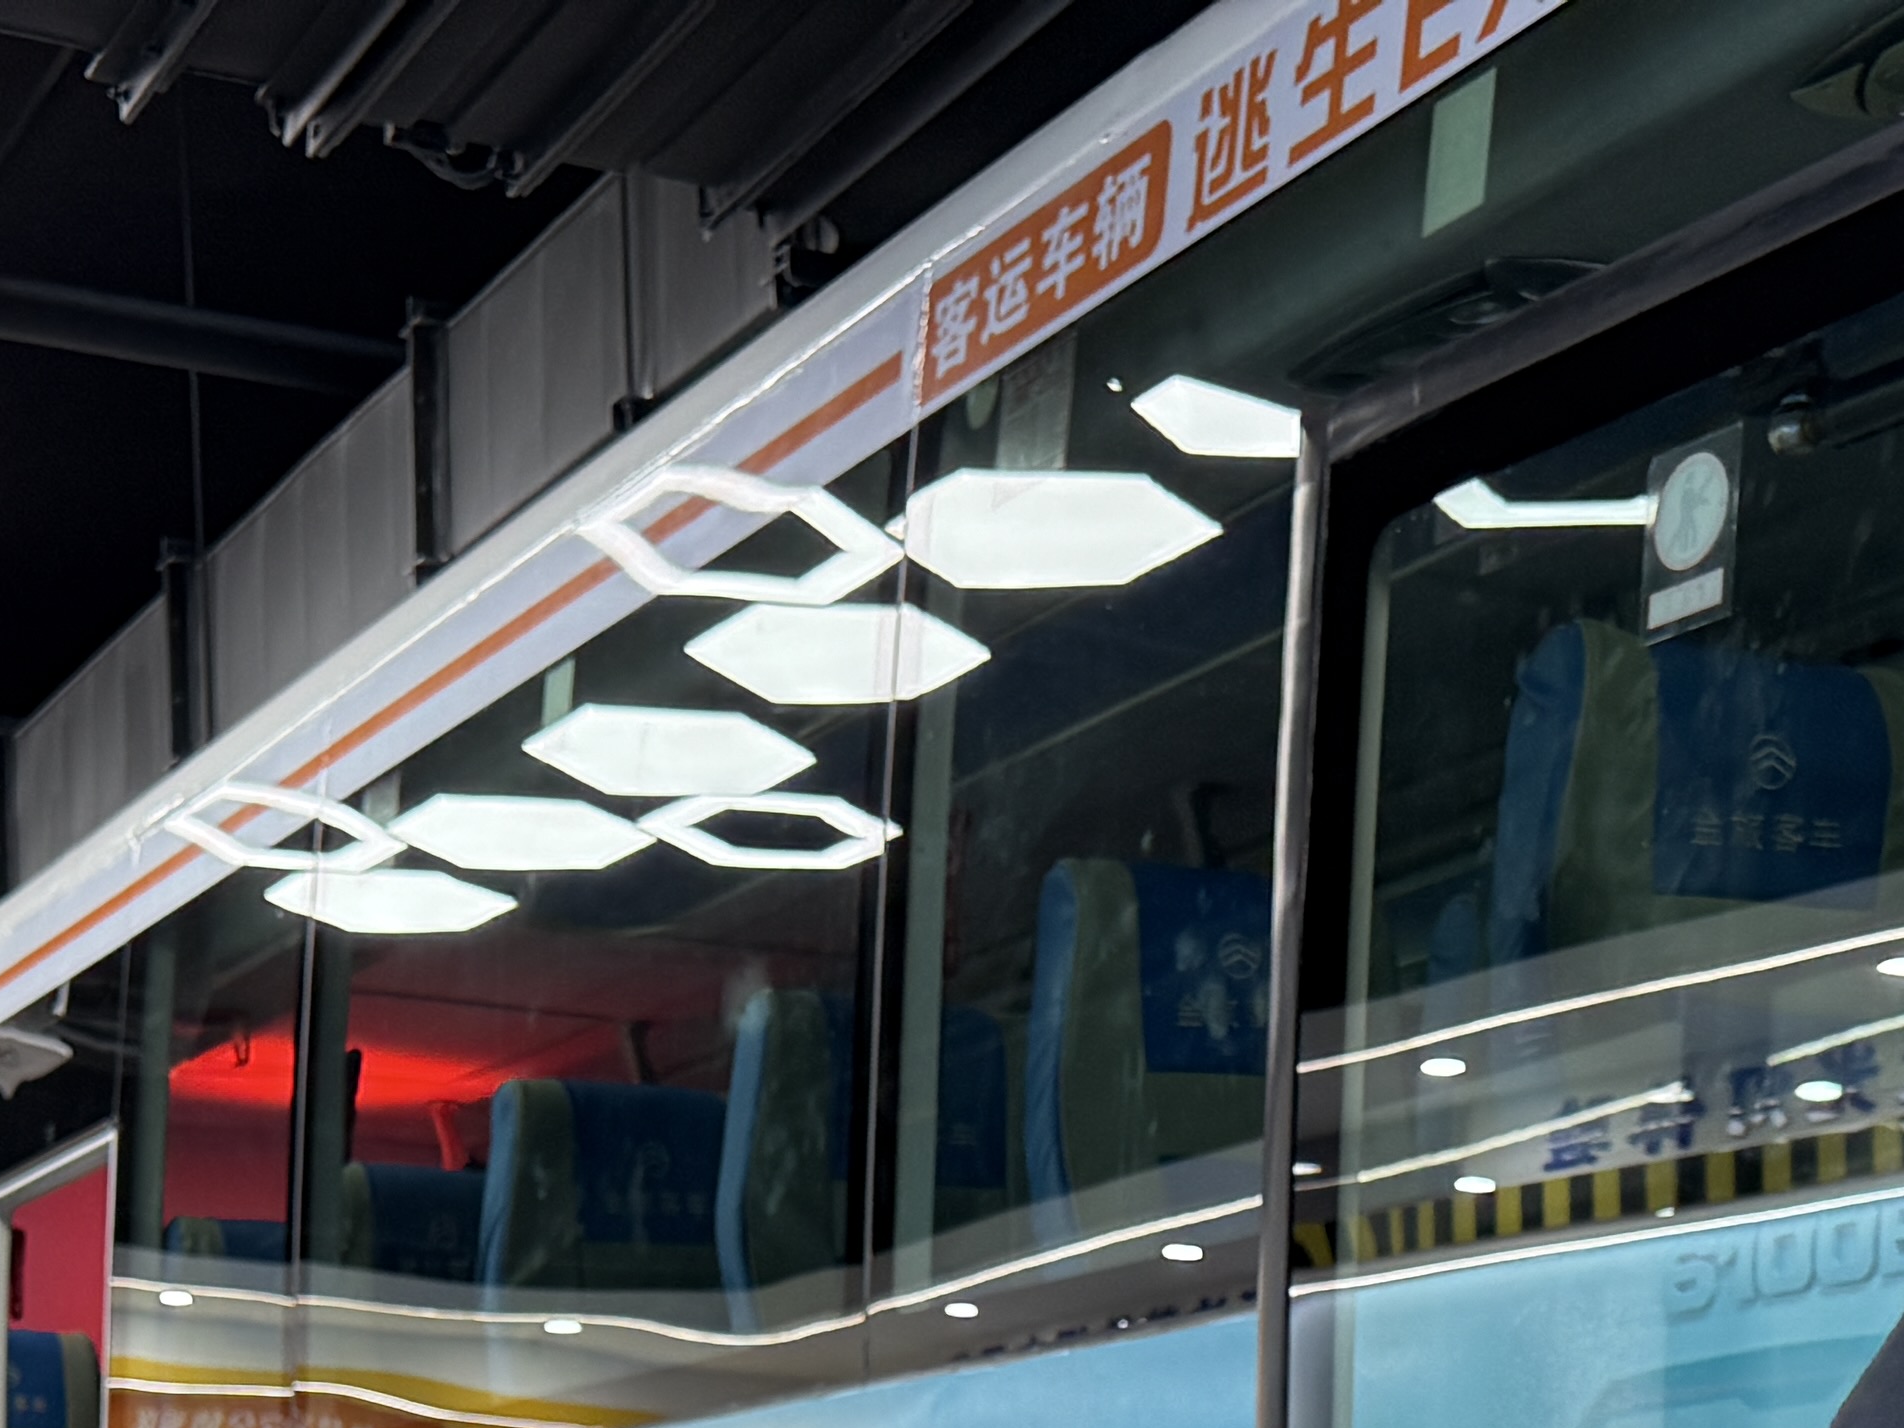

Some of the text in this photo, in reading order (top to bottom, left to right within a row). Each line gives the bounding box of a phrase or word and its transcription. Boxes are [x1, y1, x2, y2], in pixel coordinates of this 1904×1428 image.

[932, 0, 1382, 380] 客运车辆 逃生
